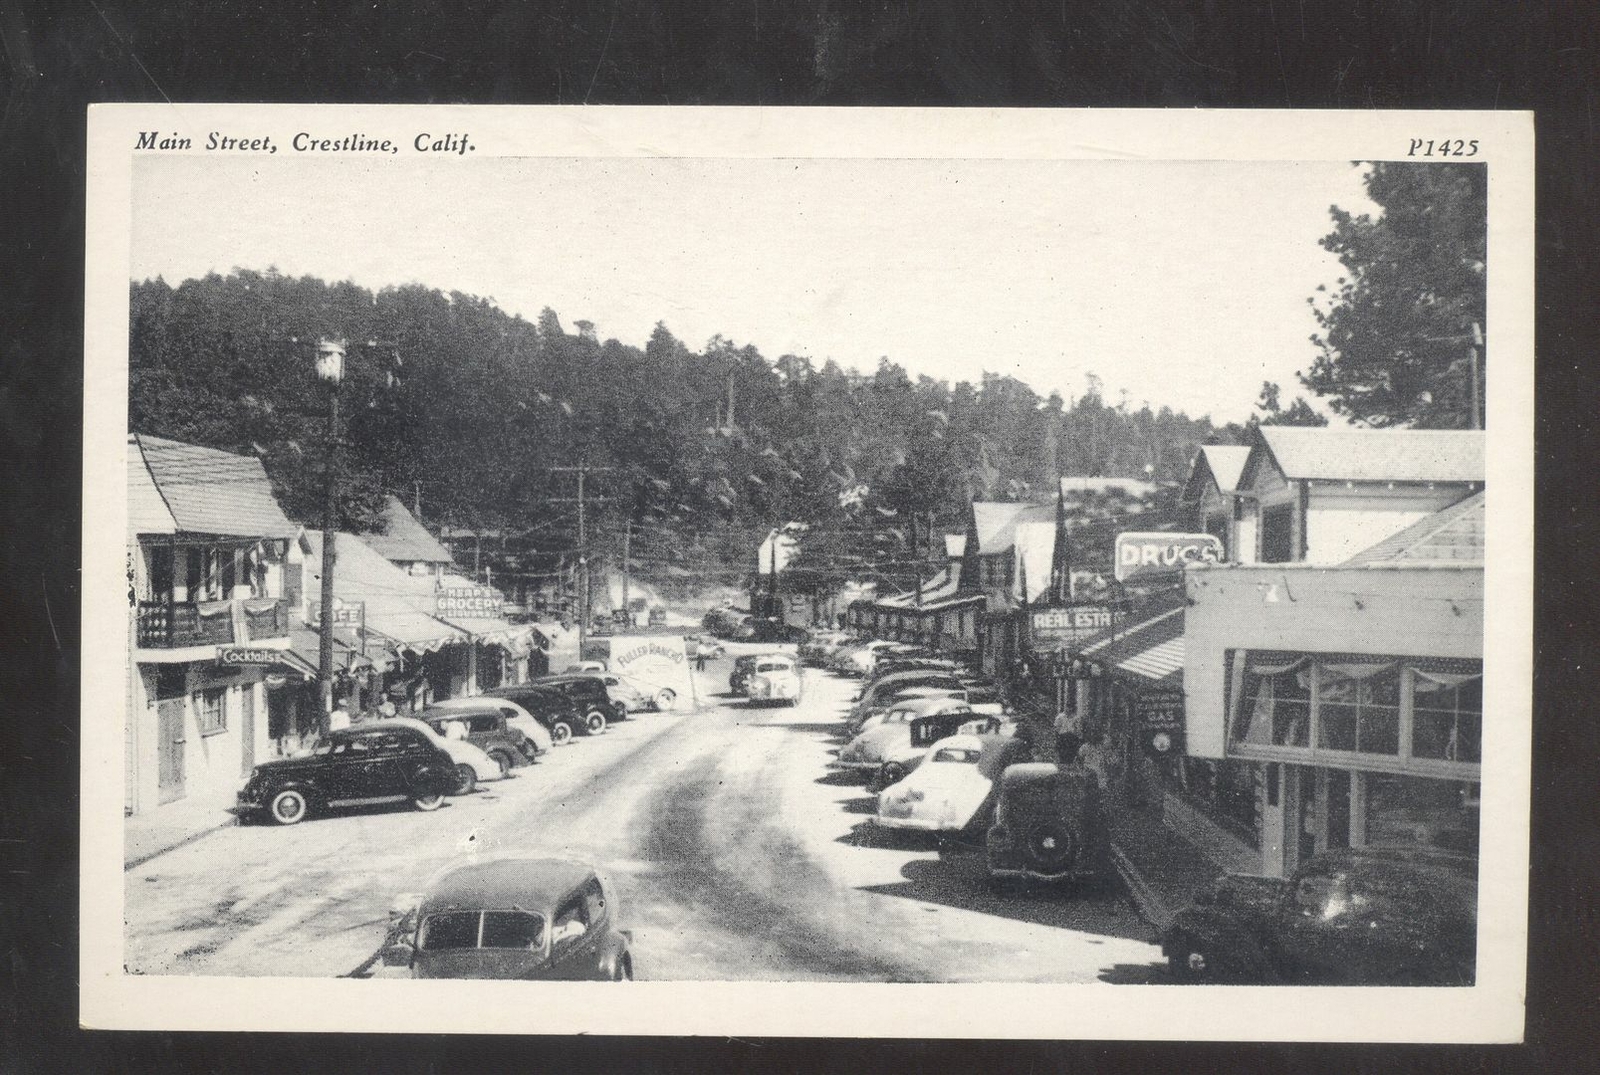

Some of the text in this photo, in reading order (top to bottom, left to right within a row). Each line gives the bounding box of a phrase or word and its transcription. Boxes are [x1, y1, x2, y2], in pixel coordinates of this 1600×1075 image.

[437, 598, 501, 610] GROCERY
[1034, 612, 1112, 628] REAL ESTA
[223, 649, 275, 664] Cocktails
